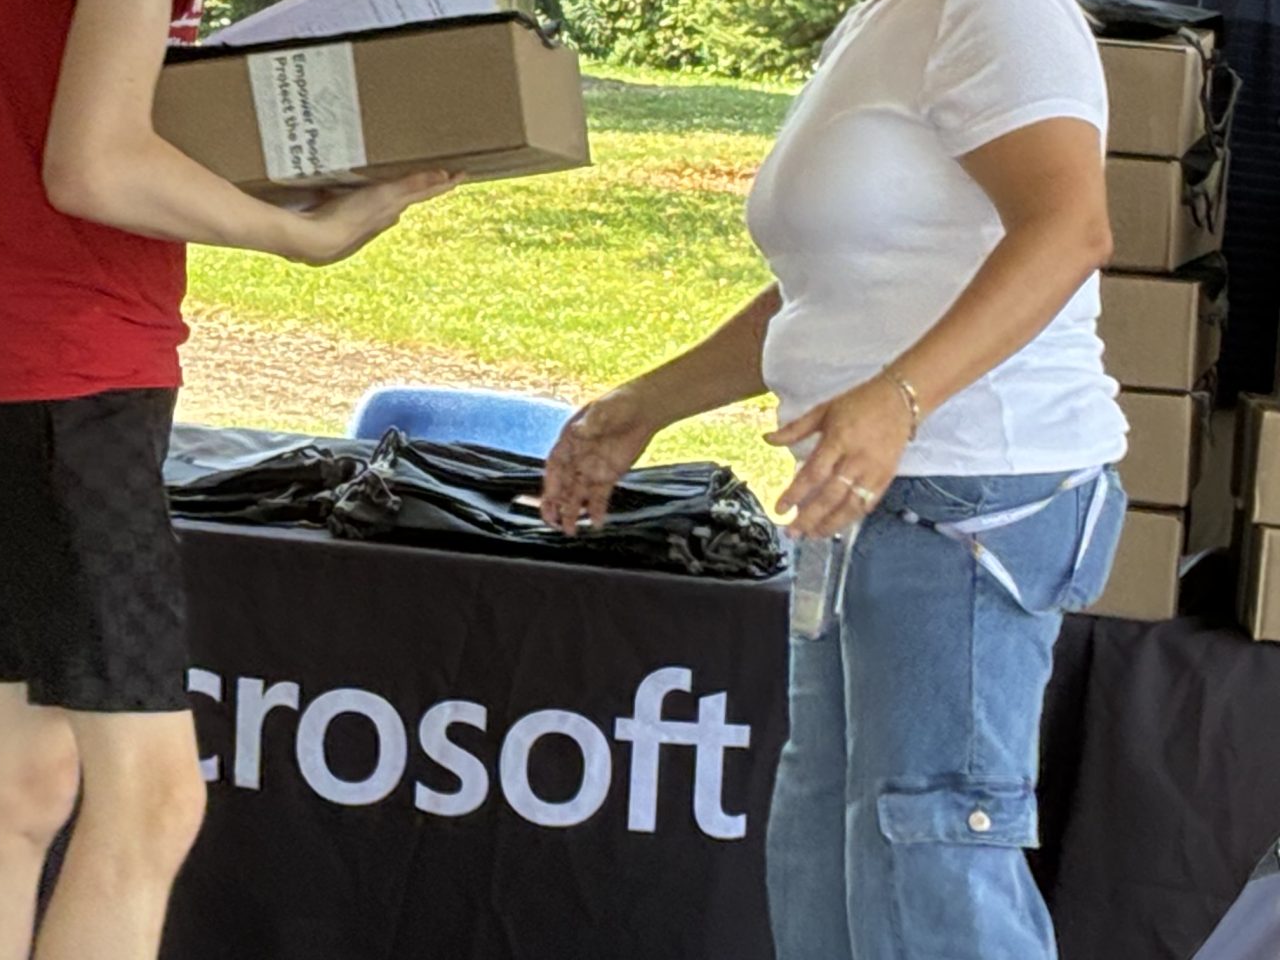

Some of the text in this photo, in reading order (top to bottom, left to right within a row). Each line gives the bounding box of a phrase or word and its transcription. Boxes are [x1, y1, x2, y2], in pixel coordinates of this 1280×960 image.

[274, 56, 296, 114] Protect
[292, 52, 315, 125] Empower
[284, 116, 301, 142] the
